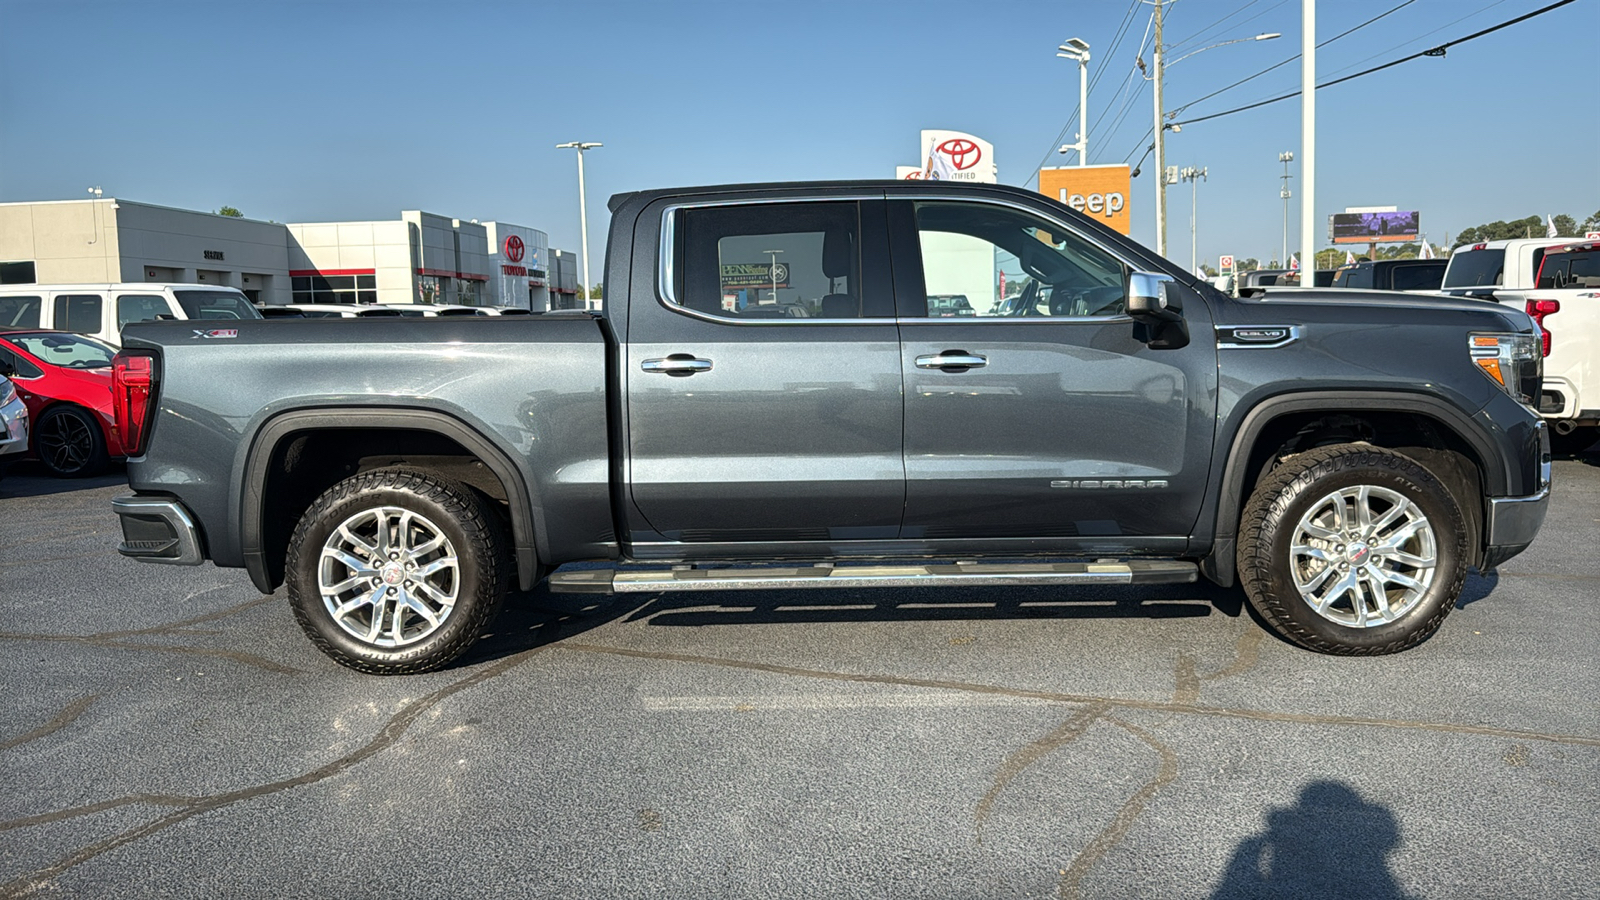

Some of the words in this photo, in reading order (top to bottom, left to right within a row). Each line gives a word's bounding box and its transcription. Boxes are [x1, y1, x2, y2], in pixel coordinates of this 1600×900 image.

[951, 172, 976, 180] TIFIED
[501, 265, 527, 276] TOYOTA
[1050, 480, 1168, 489] SIERRA
[321, 494, 381, 526] COOPER
